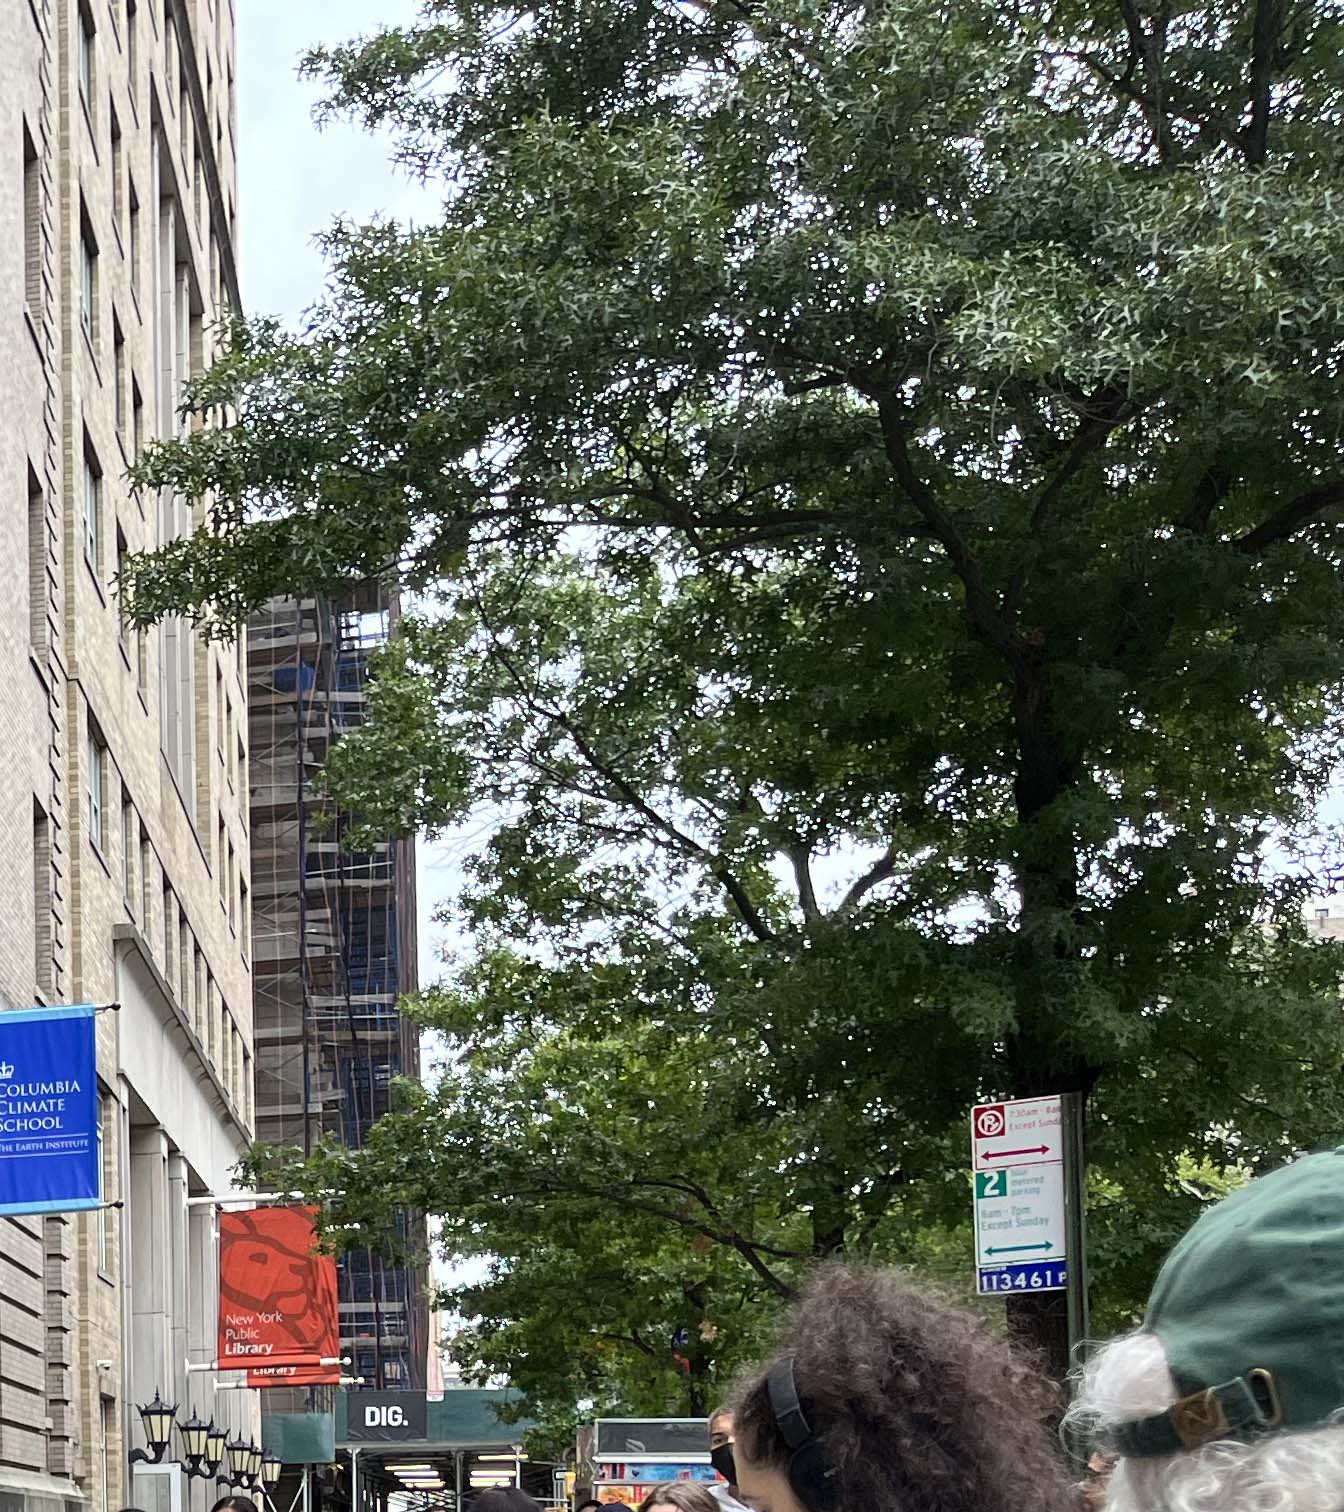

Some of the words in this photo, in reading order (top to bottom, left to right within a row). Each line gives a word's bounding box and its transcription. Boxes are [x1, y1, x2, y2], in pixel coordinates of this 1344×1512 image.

[1009, 1120, 1036, 1132] Except
[15, 1142, 43, 1152] EARTH
[45, 1139, 89, 1149] INSTITUTE
[983, 1170, 1000, 1196] 2
[981, 1219, 1012, 1231] Except
[1015, 1216, 1050, 1228] Sunday
[981, 1270, 1053, 1292] 113461
[226, 1314, 254, 1325] New
[256, 1311, 283, 1324] York
[225, 1328, 260, 1340] Public
[225, 1343, 273, 1356] Library
[364, 1406, 409, 1427] DIG.
